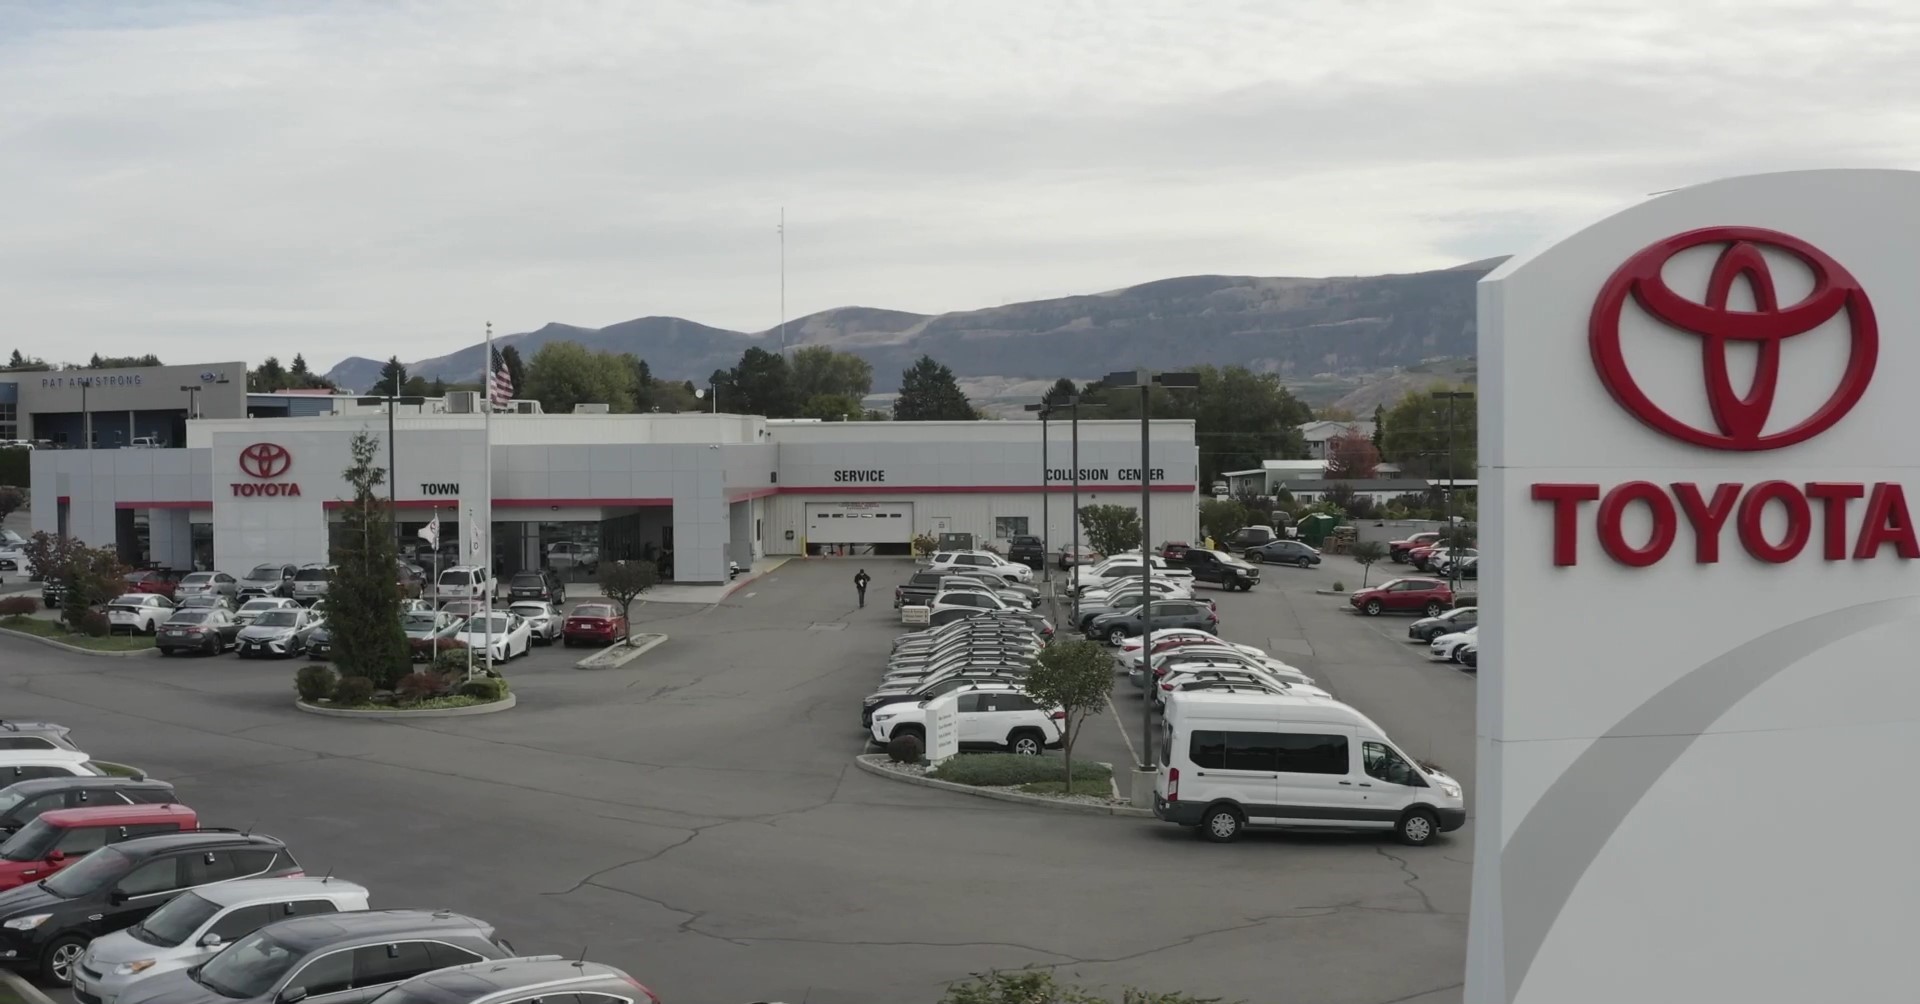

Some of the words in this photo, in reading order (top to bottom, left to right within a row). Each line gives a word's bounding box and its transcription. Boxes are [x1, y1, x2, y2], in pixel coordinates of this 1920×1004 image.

[42, 378, 62, 388] PAT
[834, 470, 885, 482] SERVICE
[1046, 469, 1108, 480] COLLSION
[1118, 469, 1164, 480] CENER
[230, 483, 301, 497] TOYOTA
[421, 483, 460, 495] TOWN
[1531, 480, 1920, 567] TOYOTA
